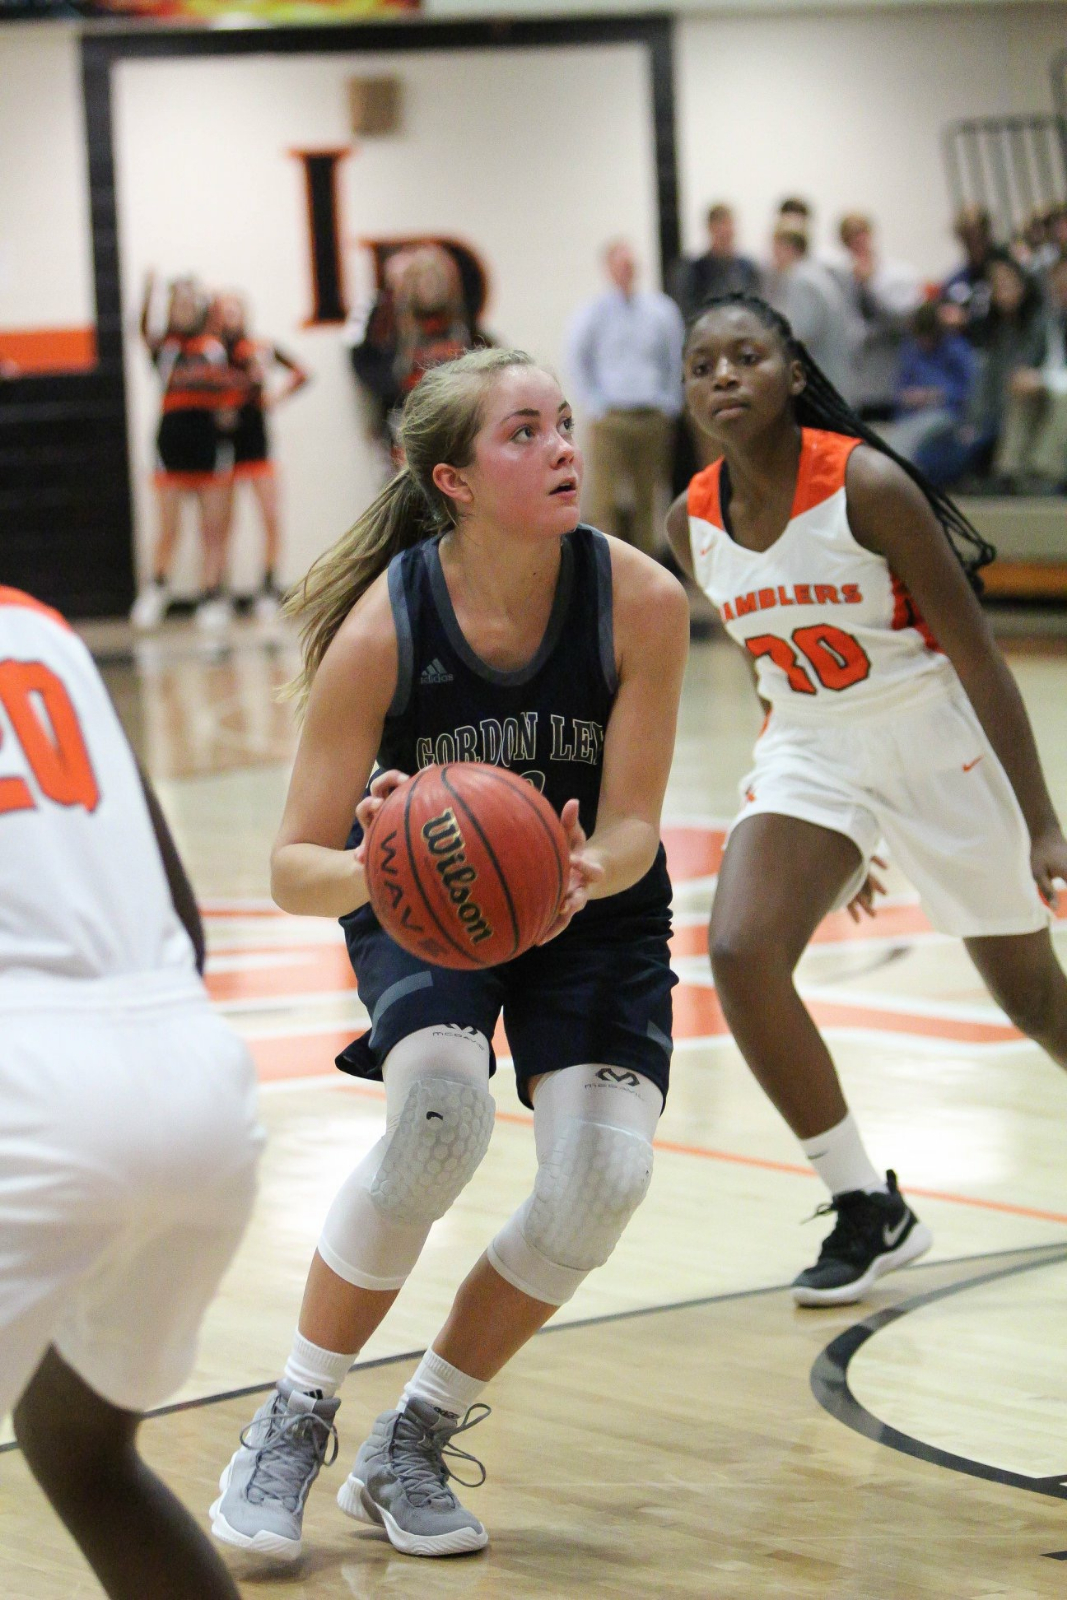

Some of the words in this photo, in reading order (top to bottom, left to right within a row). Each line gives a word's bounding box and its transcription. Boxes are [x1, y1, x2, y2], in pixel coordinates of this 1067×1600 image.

[718, 584, 863, 622] AMBLERS
[416, 712, 538, 770] GORDON
[421, 806, 494, 946] Wilson
